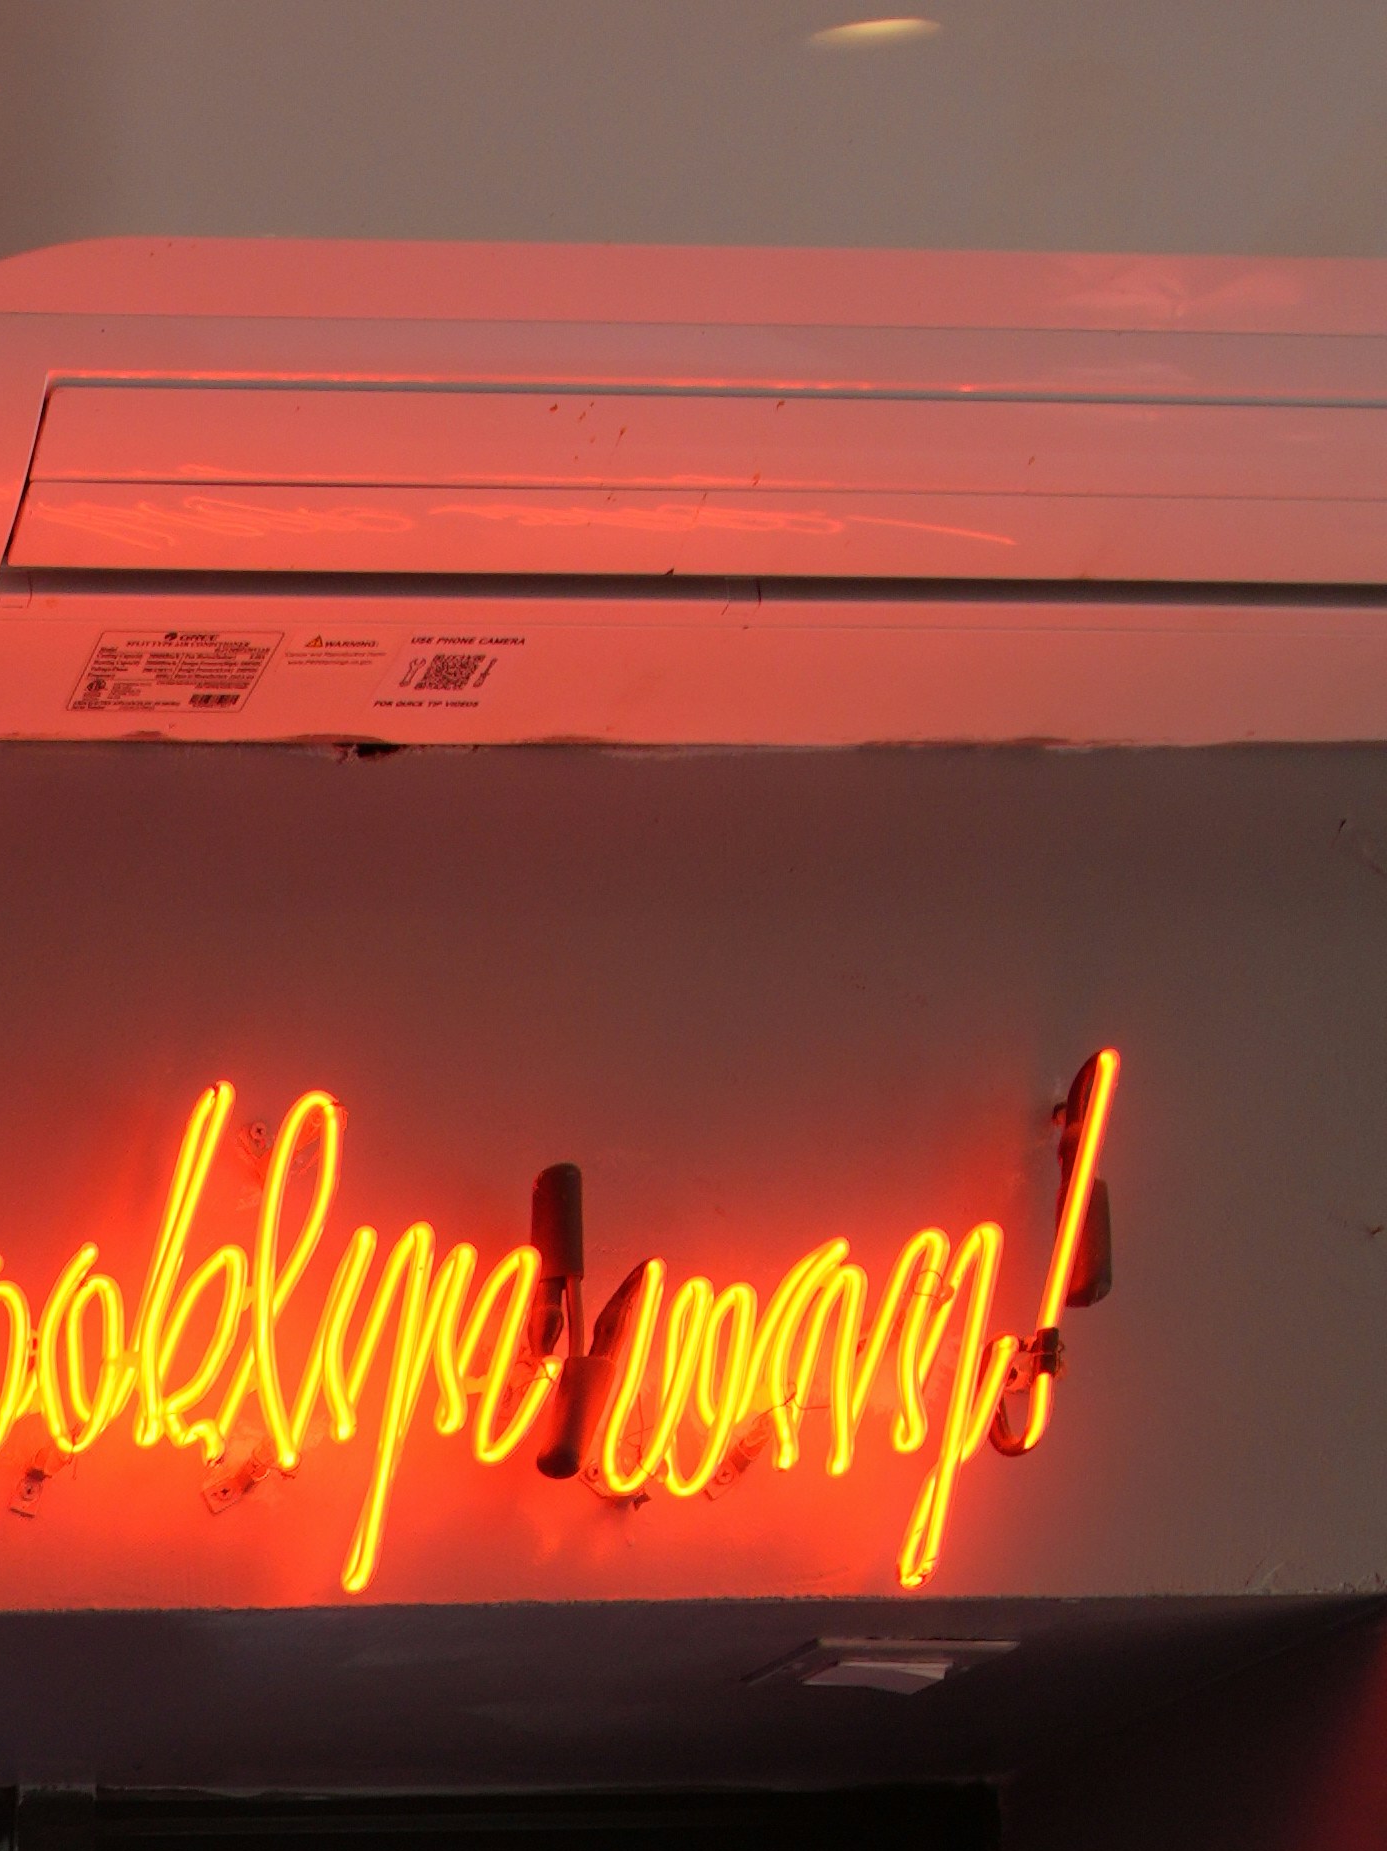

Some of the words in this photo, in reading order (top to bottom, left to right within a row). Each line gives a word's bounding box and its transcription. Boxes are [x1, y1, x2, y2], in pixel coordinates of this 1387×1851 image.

[411, 636, 433, 645] USE
[437, 636, 476, 645] PHONE
[478, 636, 526, 645] CAMERA
[602, 1048, 1121, 1590] way!
